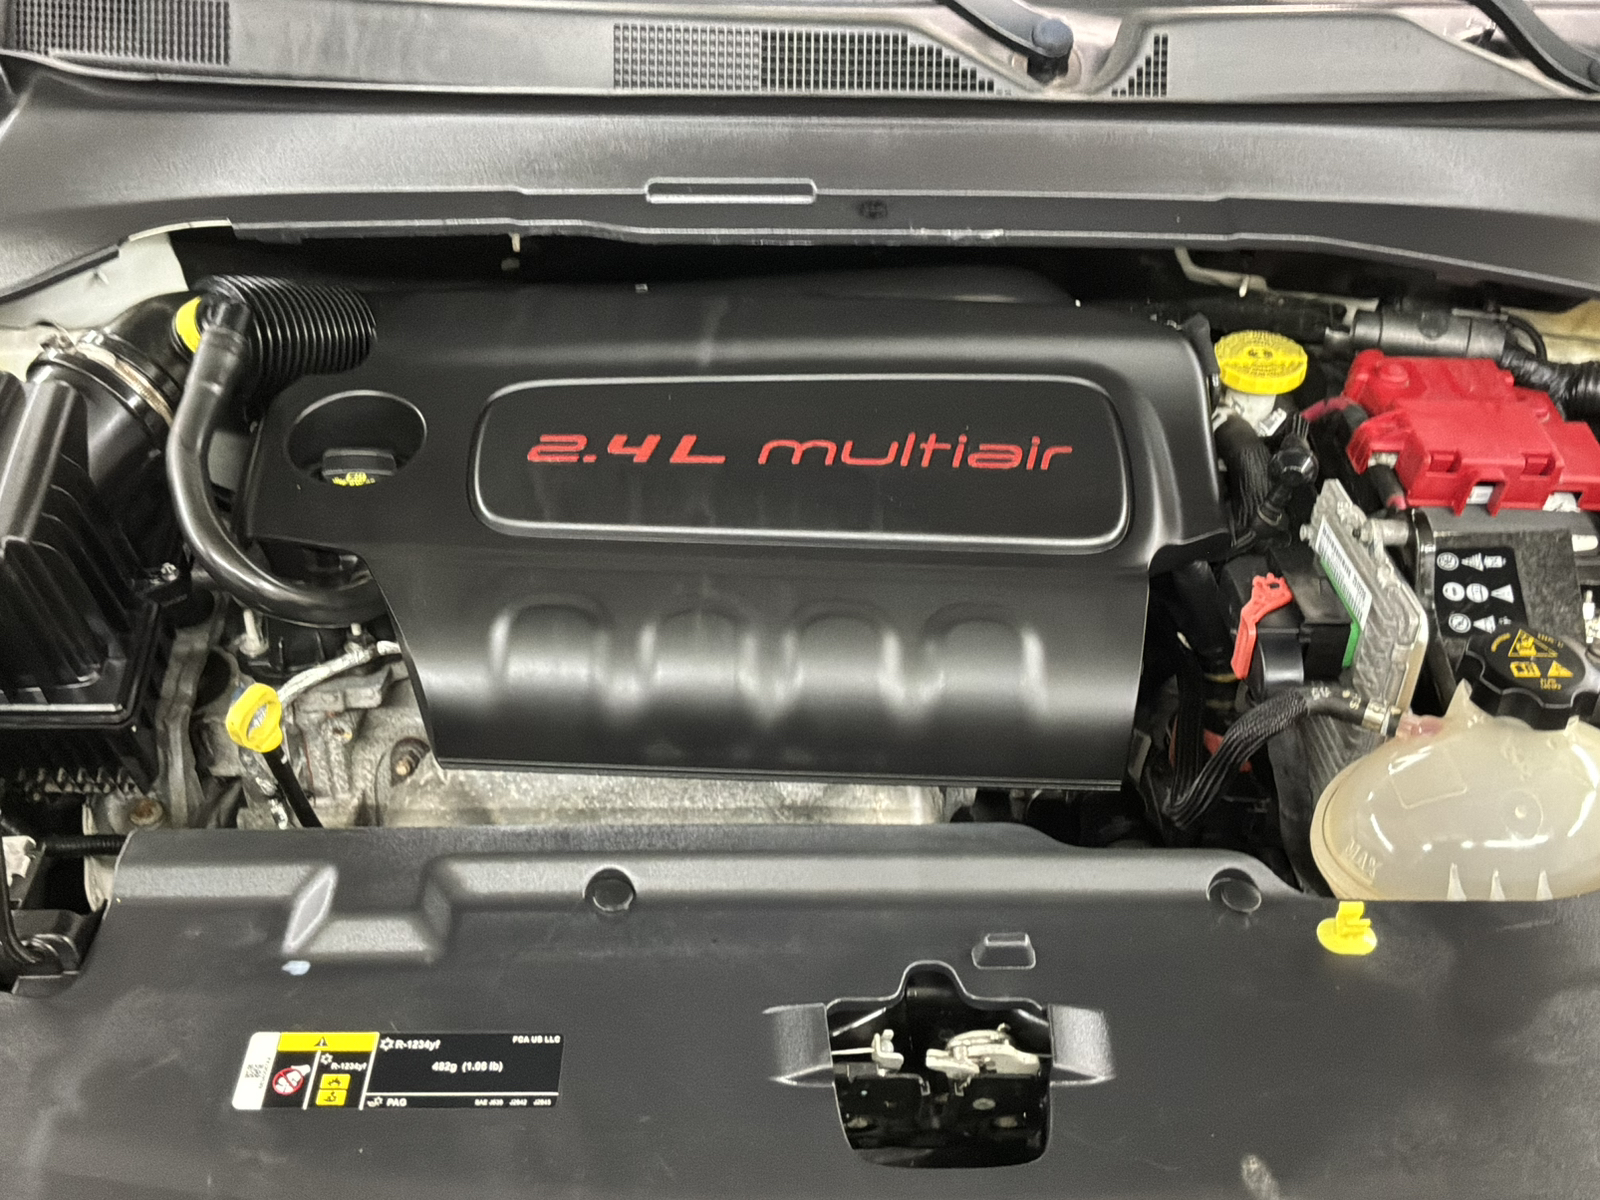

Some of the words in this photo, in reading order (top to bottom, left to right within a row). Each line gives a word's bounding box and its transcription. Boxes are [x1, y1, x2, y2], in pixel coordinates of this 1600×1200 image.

[757, 431, 1073, 470] multiair
[394, 1038, 442, 1052] R-1234yf
[488, 1060, 504, 1073] lb)
